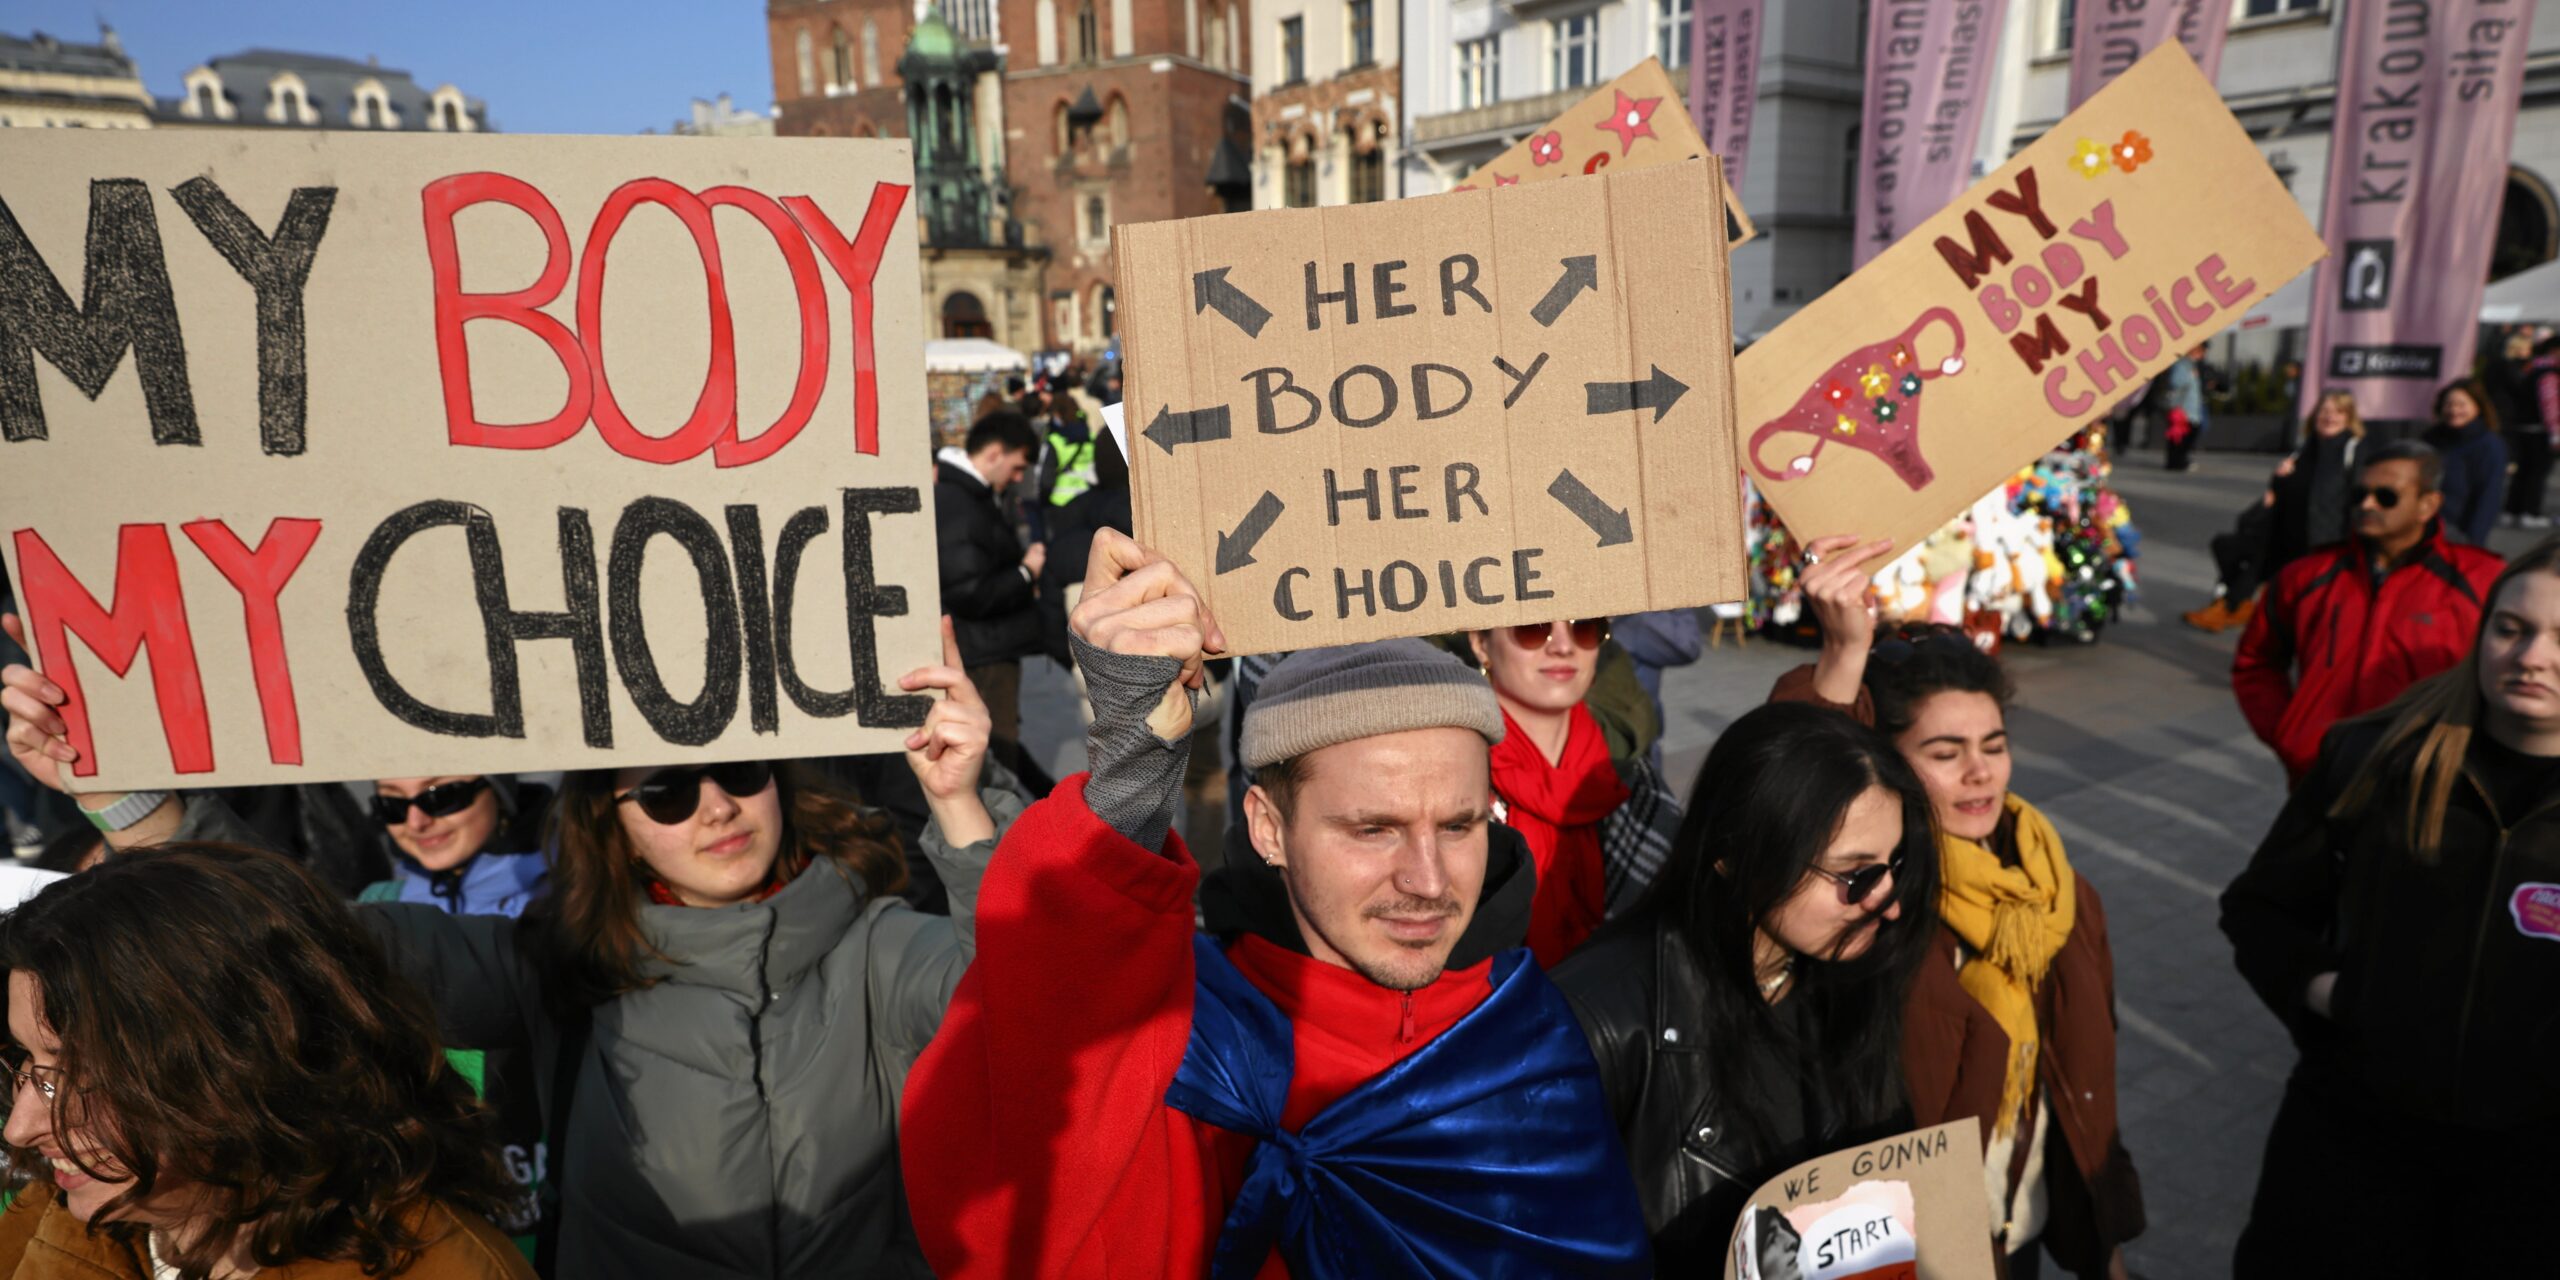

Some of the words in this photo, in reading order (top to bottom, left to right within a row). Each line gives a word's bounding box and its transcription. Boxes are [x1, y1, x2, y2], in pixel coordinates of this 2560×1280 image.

[1731, 8, 1753, 127] miasta
[1939, 0, 1983, 90] mias
[2450, 18, 2516, 103] siłą
[1871, 0, 1928, 243] krakowian
[1921, 99, 1970, 164] siłą
[1933, 166, 2058, 290] MY
[1977, 198, 2130, 334] BODY
[0, 175, 338, 457] MY
[421, 171, 911, 468] BODY
[1305, 253, 1492, 330] HER
[2009, 275, 2112, 376] MY
[1242, 352, 1549, 434] BODY
[1324, 462, 1489, 526] HER
[1273, 548, 1554, 621] CHOICE
[13, 516, 323, 777] MY
[346, 486, 935, 749] CHOICE
[1784, 1167, 1820, 1201] WE
[1852, 1130, 1948, 1177] GONNA
[1817, 1215, 1894, 1269] START
